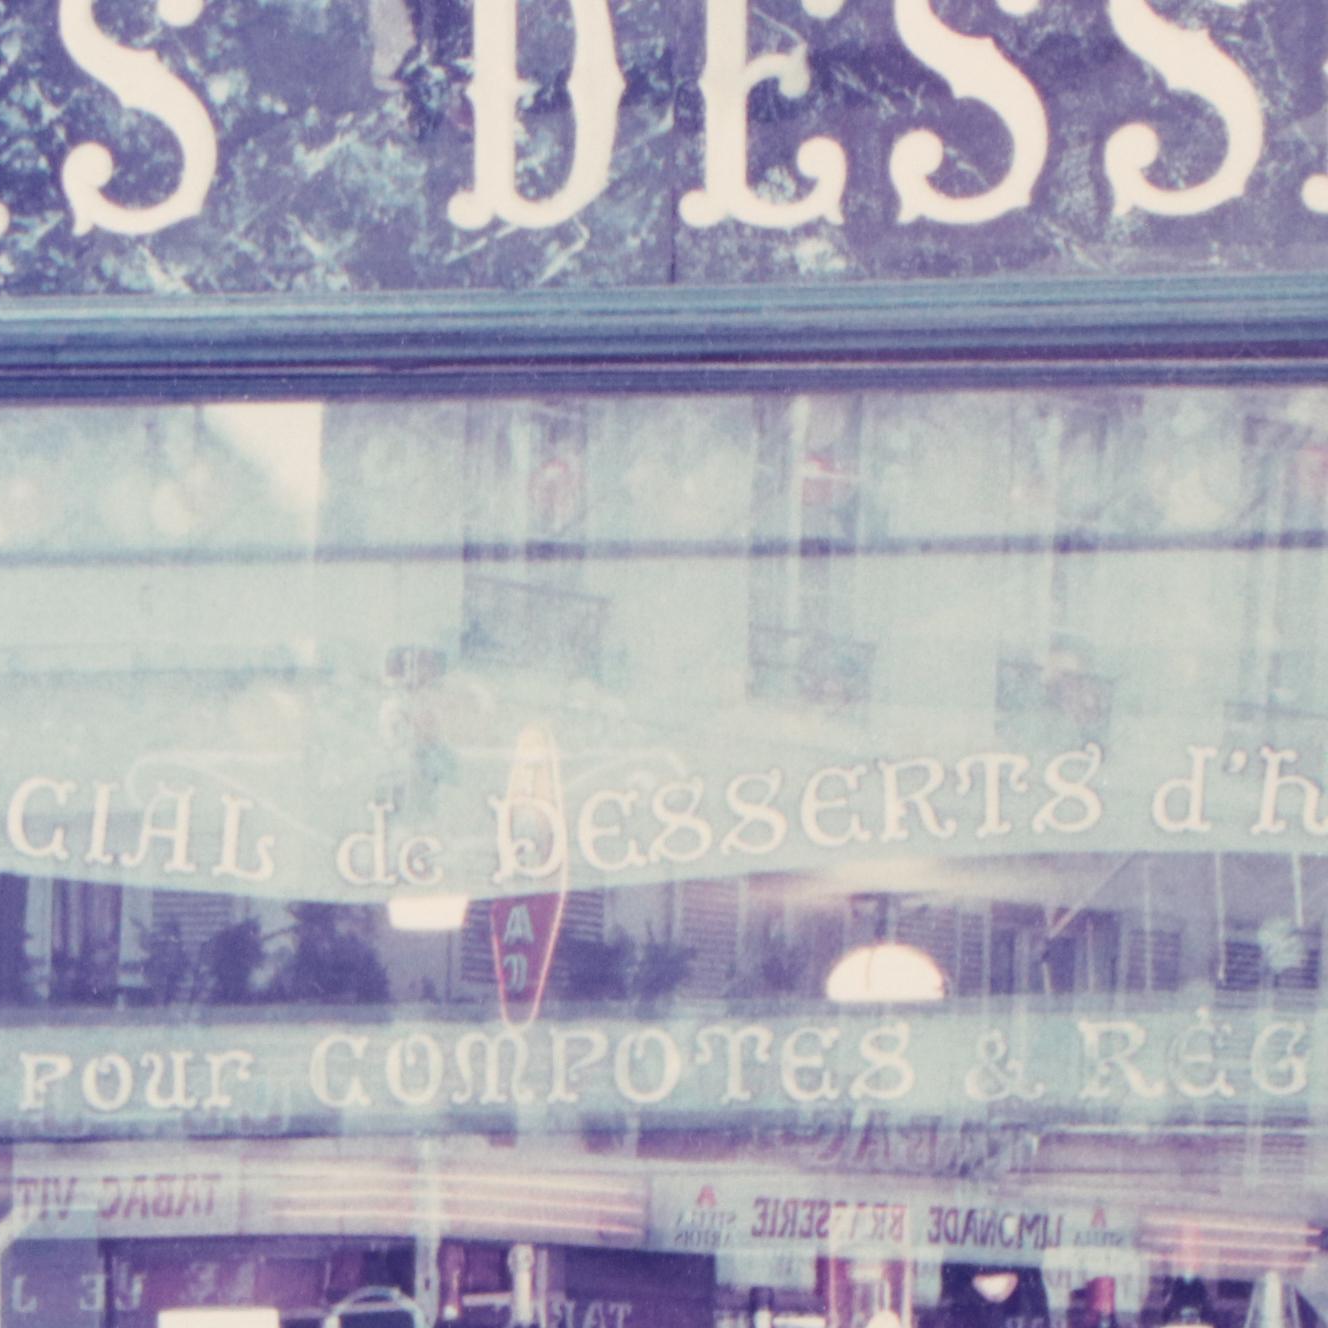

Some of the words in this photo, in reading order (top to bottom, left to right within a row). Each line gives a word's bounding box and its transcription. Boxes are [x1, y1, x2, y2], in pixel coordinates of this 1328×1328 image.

[447, 0, 1328, 229] DESS
[336, 800, 445, 886] de
[488, 742, 1104, 884] DESSERTS
[308, 1022, 915, 1108] COMPOTES
[965, 1026, 1045, 1102] &
